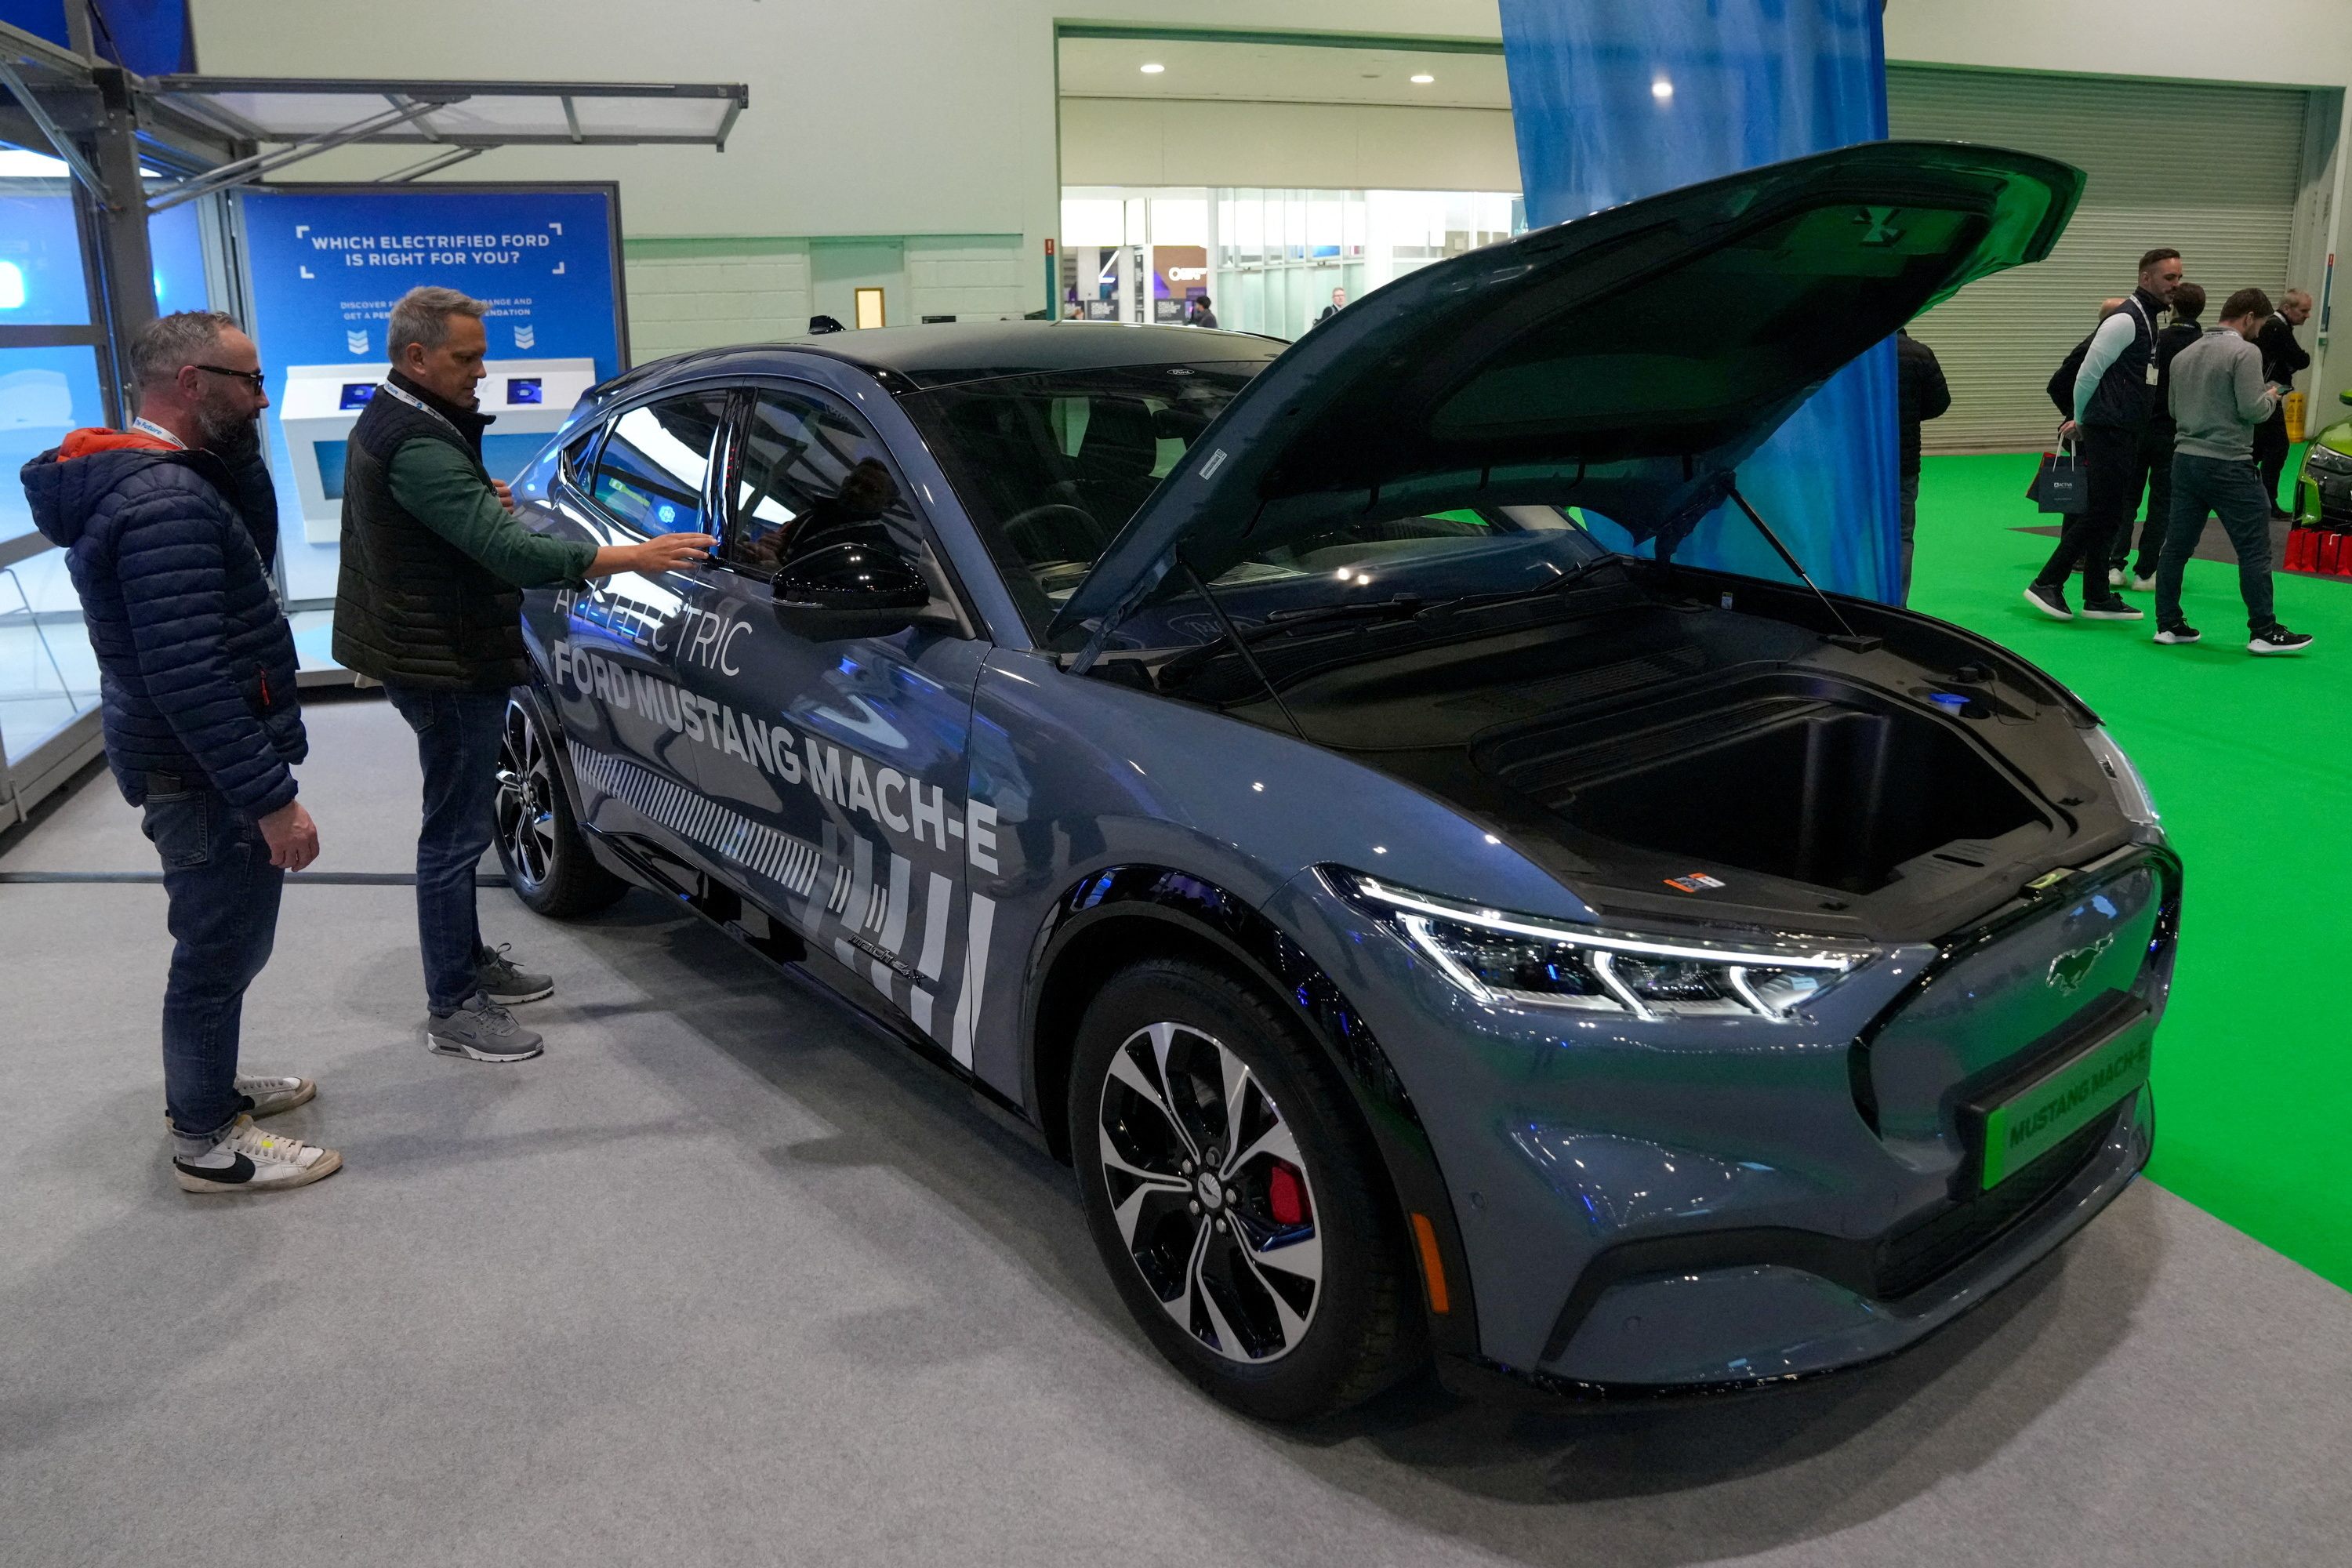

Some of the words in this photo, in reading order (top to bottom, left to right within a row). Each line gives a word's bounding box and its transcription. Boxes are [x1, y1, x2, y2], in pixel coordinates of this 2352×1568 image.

[311, 236, 375, 249] WHICH
[380, 235, 497, 249] ELECTRIFIED
[502, 234, 549, 247] FORD
[346, 253, 364, 266] IS
[369, 252, 425, 266] RIGHT
[431, 252, 466, 265] FOR
[472, 251, 521, 264] YOU?
[340, 300, 387, 310] DISCOVER
[343, 312, 361, 321] GET
[141, 422, 163, 435] Future
[553, 580, 753, 677] ALL-ELECTRIC
[554, 639, 630, 710] FORD
[631, 668, 801, 785] MUSTANG
[804, 737, 999, 876] MACH-E
[2009, 1079, 2089, 1149] MUSTANG
[2091, 1040, 2148, 1095] MACH-E
